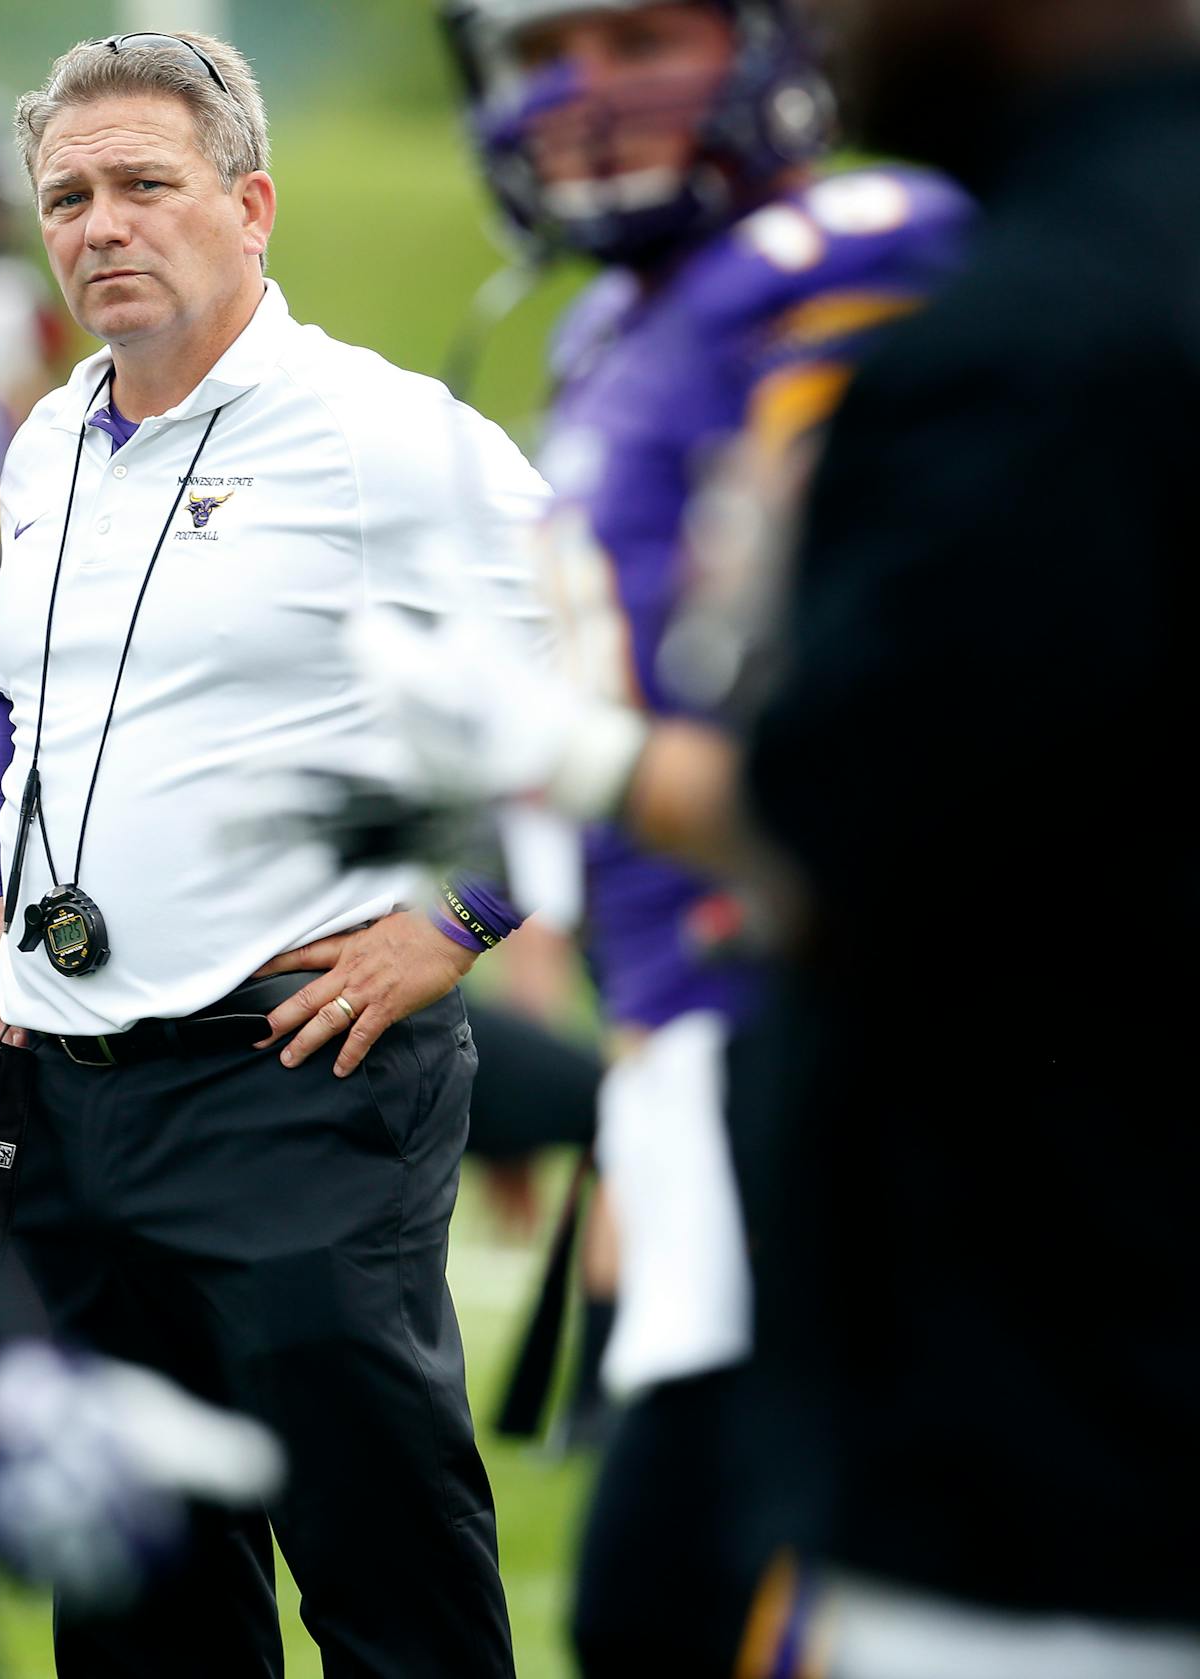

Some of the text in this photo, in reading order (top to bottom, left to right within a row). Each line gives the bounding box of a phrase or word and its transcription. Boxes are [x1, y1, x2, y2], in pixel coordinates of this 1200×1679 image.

[177, 476, 253, 487] MNNESOTA STATE
[174, 531, 218, 541] FOOTBALL
[446, 890, 497, 947] NEED IT JU
